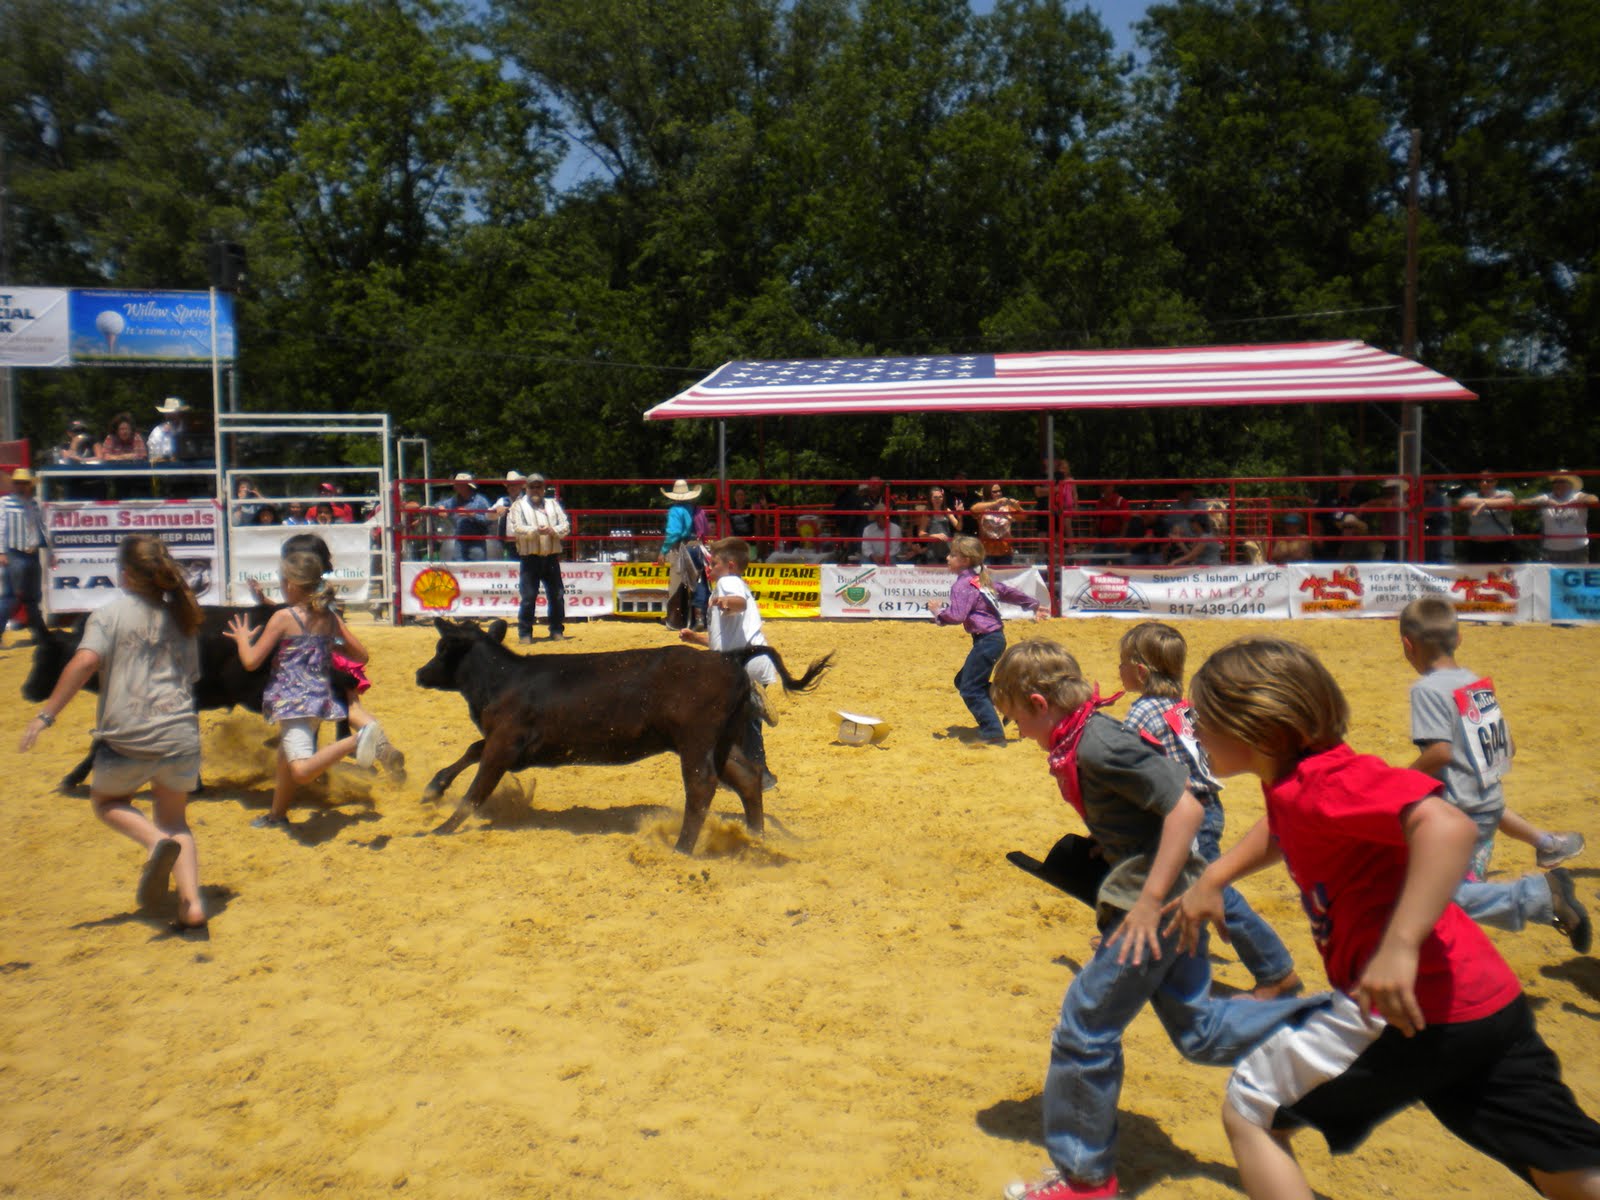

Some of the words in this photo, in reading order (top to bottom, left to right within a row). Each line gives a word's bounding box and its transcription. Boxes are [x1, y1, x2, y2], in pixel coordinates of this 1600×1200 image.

[123, 301, 168, 317] Willow
[172, 304, 216, 325] Spring
[52, 512, 108, 527] Allen
[117, 510, 214, 526] Samuels
[55, 534, 112, 544] CHRYSLER
[160, 533, 182, 542] EEP
[186, 533, 212, 542] RAM
[334, 568, 365, 578] Clinic
[461, 570, 501, 578] Texas
[560, 570, 604, 580] ountry
[618, 567, 670, 577] HASLET
[780, 567, 817, 578] CARE
[1153, 574, 1189, 583] Steven
[1193, 574, 1203, 583] S.
[1206, 573, 1242, 584] Isham,
[1246, 572, 1282, 582] LUTCF
[53, 575, 116, 589] RA
[884, 588, 900, 596] 1195
[902, 588, 915, 596] FM
[933, 589, 950, 597] Sout
[1167, 587, 1266, 599] FARMERS
[1170, 603, 1266, 615] 817-439-0410
